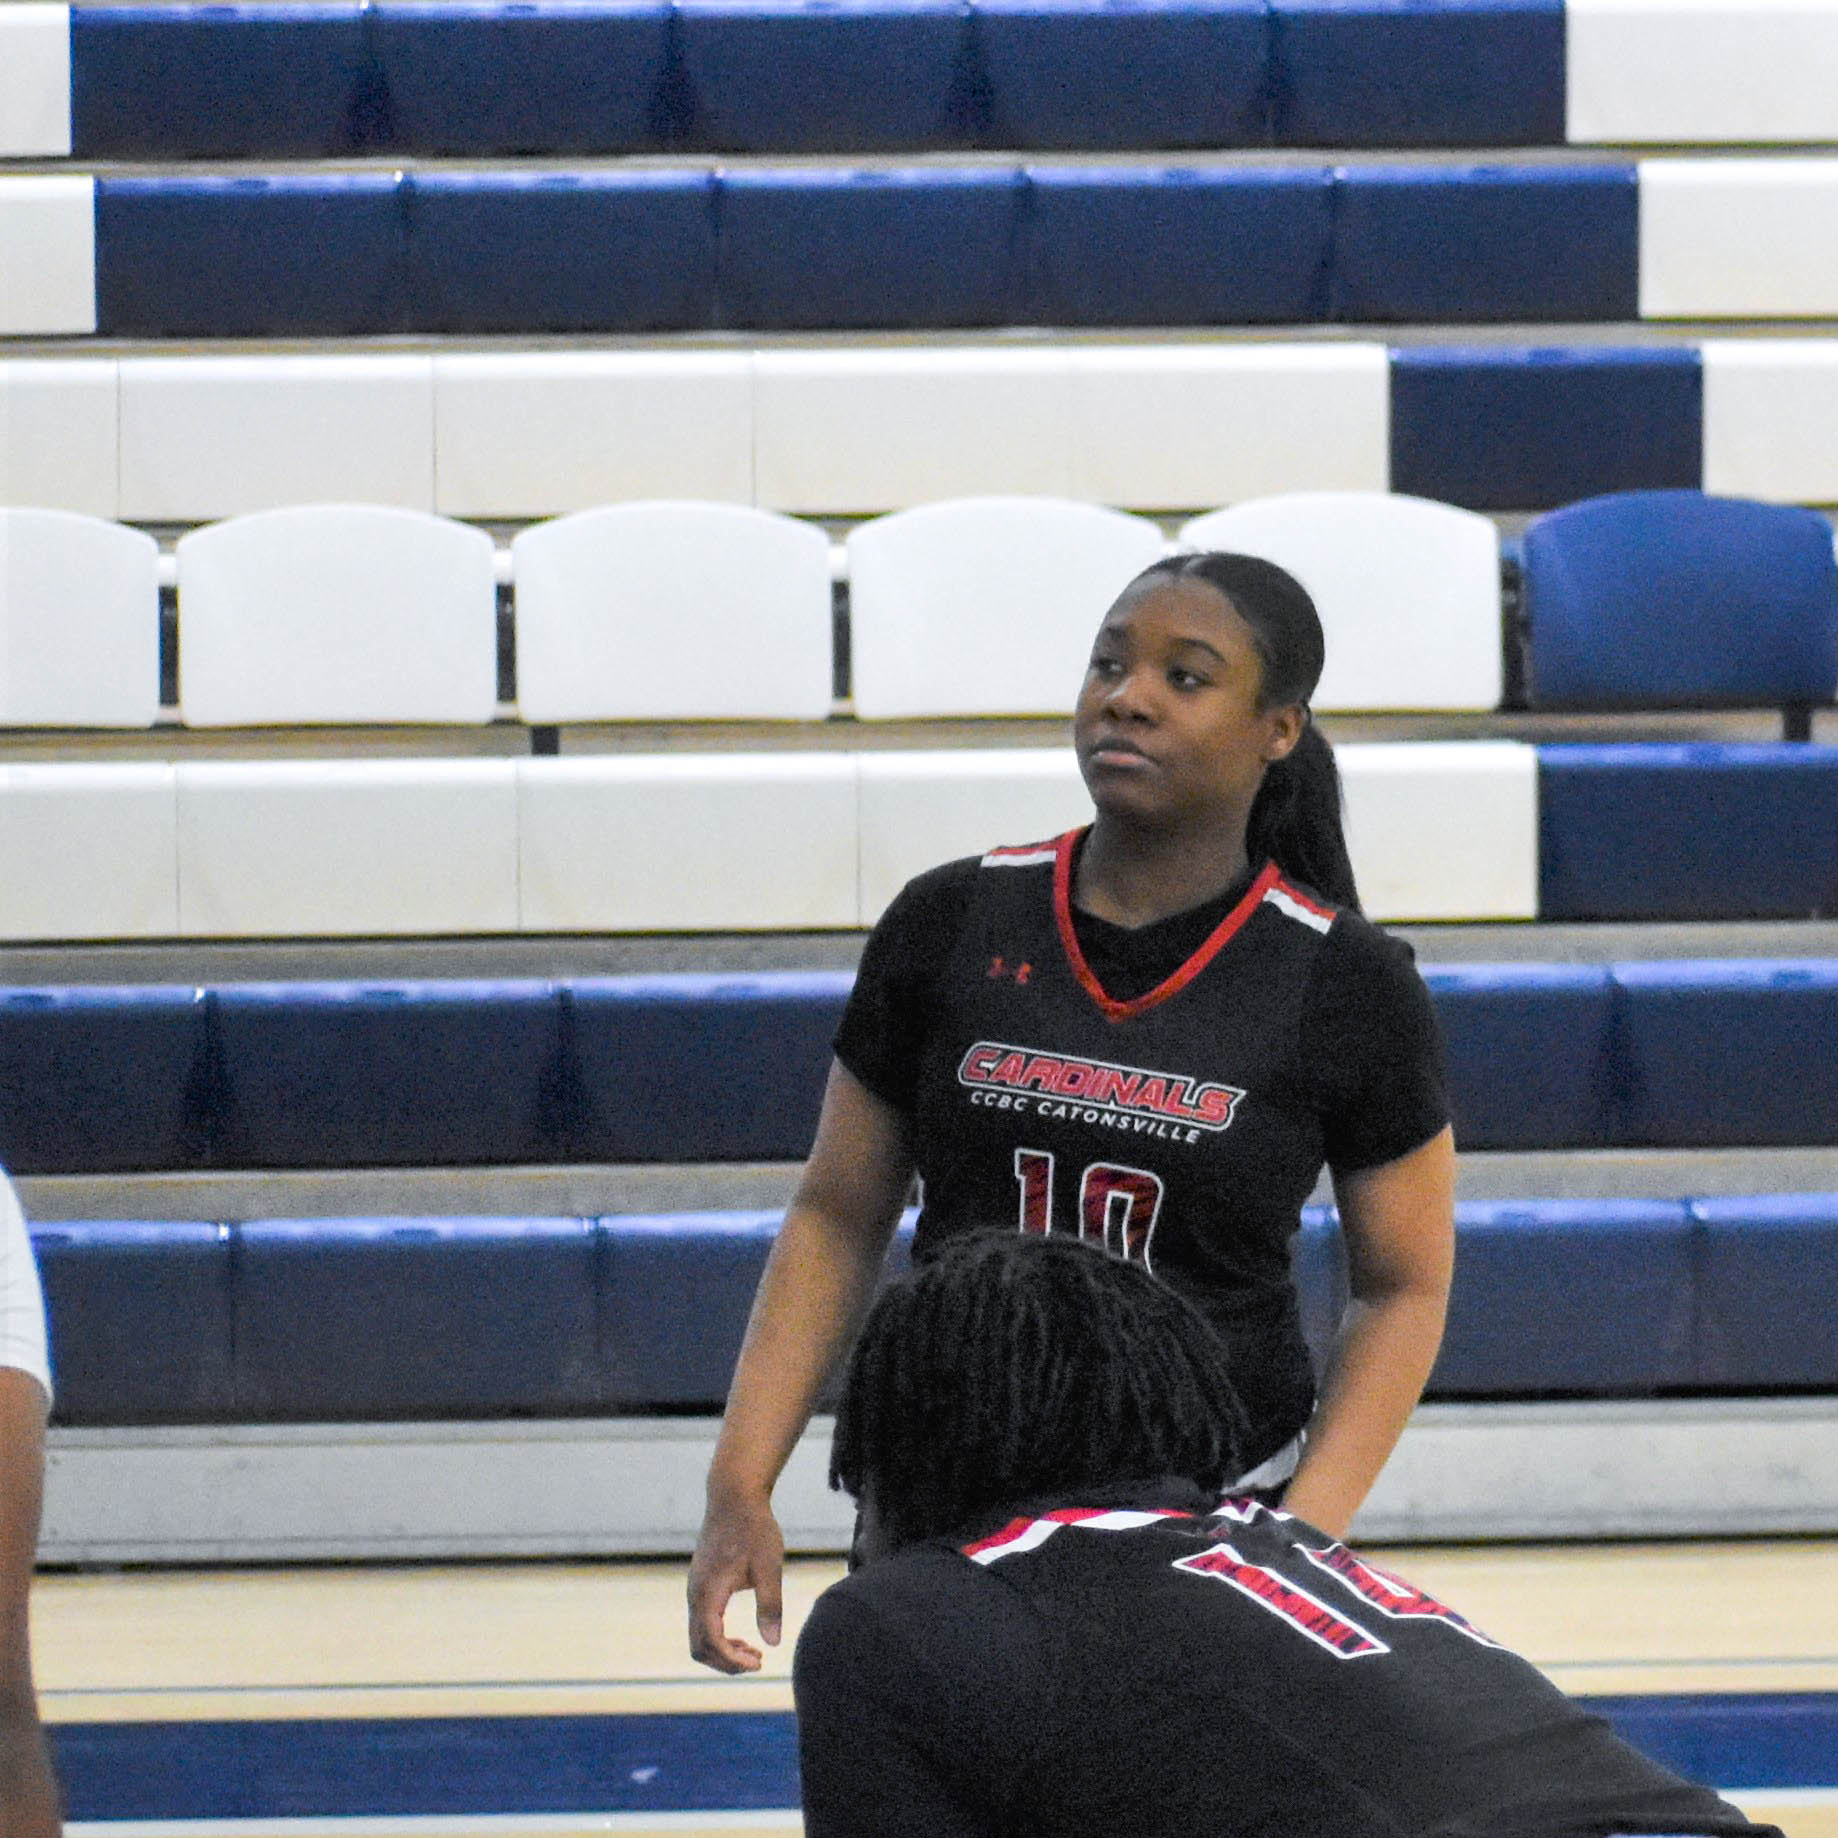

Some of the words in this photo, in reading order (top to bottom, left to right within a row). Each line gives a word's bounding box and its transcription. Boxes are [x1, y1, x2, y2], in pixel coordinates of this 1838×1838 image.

[958, 1041, 1247, 1131] CARDINALS
[970, 1090, 1029, 1111] CCBC
[1037, 1101, 1201, 1144] CATONSVILLE
